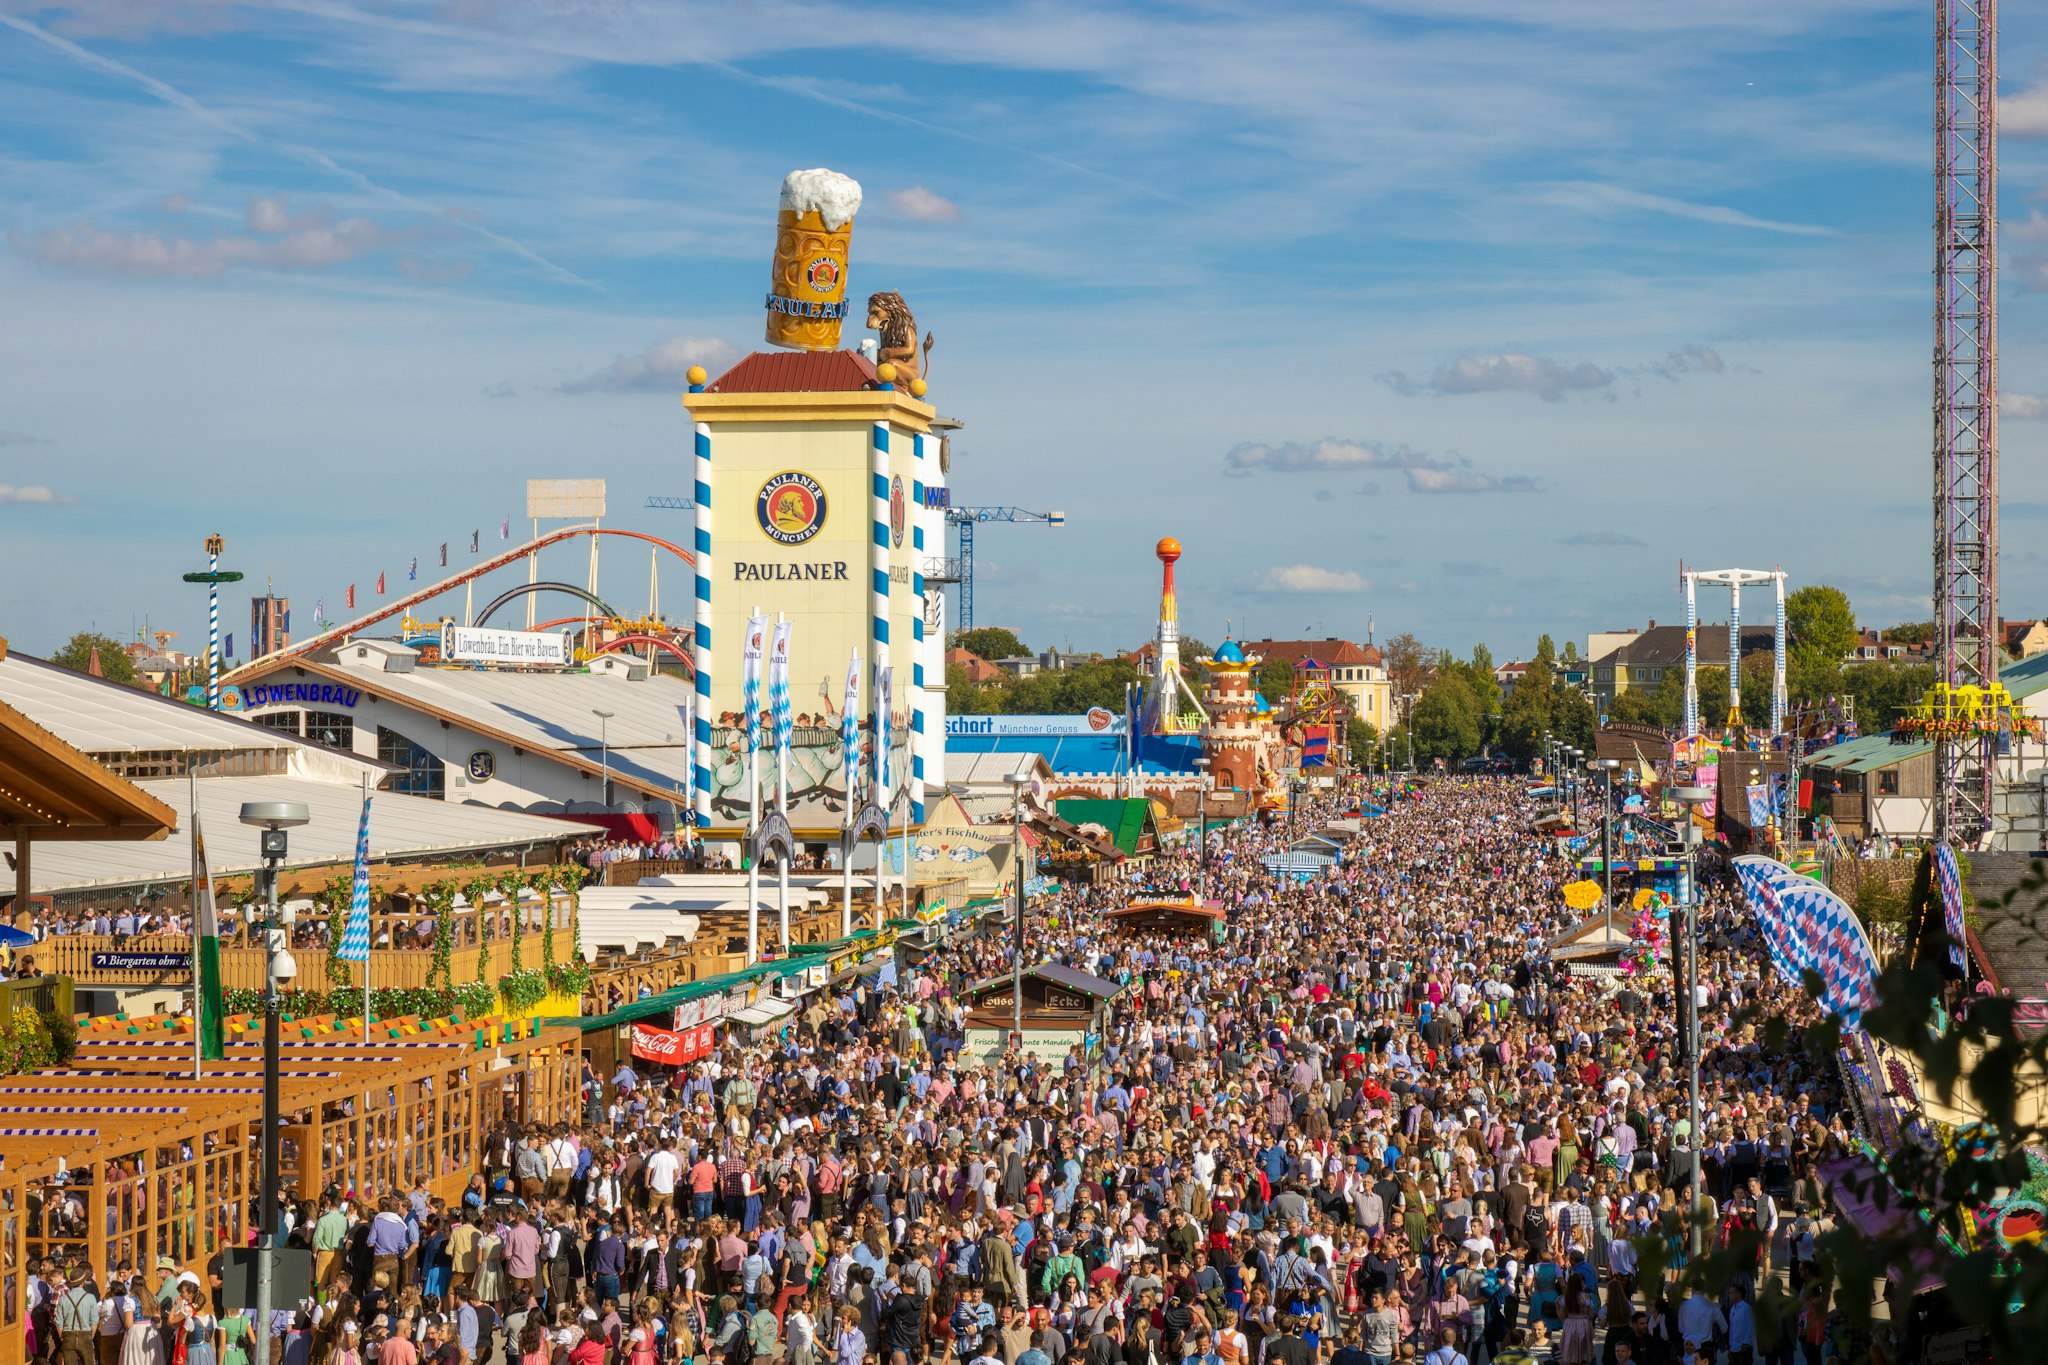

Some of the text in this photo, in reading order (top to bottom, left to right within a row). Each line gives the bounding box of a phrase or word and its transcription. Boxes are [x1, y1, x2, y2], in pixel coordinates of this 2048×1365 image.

[760, 473, 823, 500] PAULANER
[765, 524, 818, 542] MÜNCHEN
[734, 561, 848, 581] PAULANER
[459, 633, 497, 654] Löwenbräu.
[498, 636, 509, 655] Ein
[511, 637, 524, 656] Bier
[525, 638, 535, 657] wie
[537, 638, 560, 662] Bayern.
[242, 683, 360, 709] LÖWENBRÄU
[1000, 723, 1043, 733] Münchner
[1046, 725, 1078, 733] Genuss
[946, 827, 990, 842] Fischhau
[1135, 894, 1188, 904] Heisse Nüsse
[108, 954, 156, 968] Biergarten
[158, 954, 180, 966] ohne
[1049, 995, 1080, 1007] Ecke
[974, 1038, 1000, 1046] Frische
[1043, 1038, 1074, 1046] Mandeln
